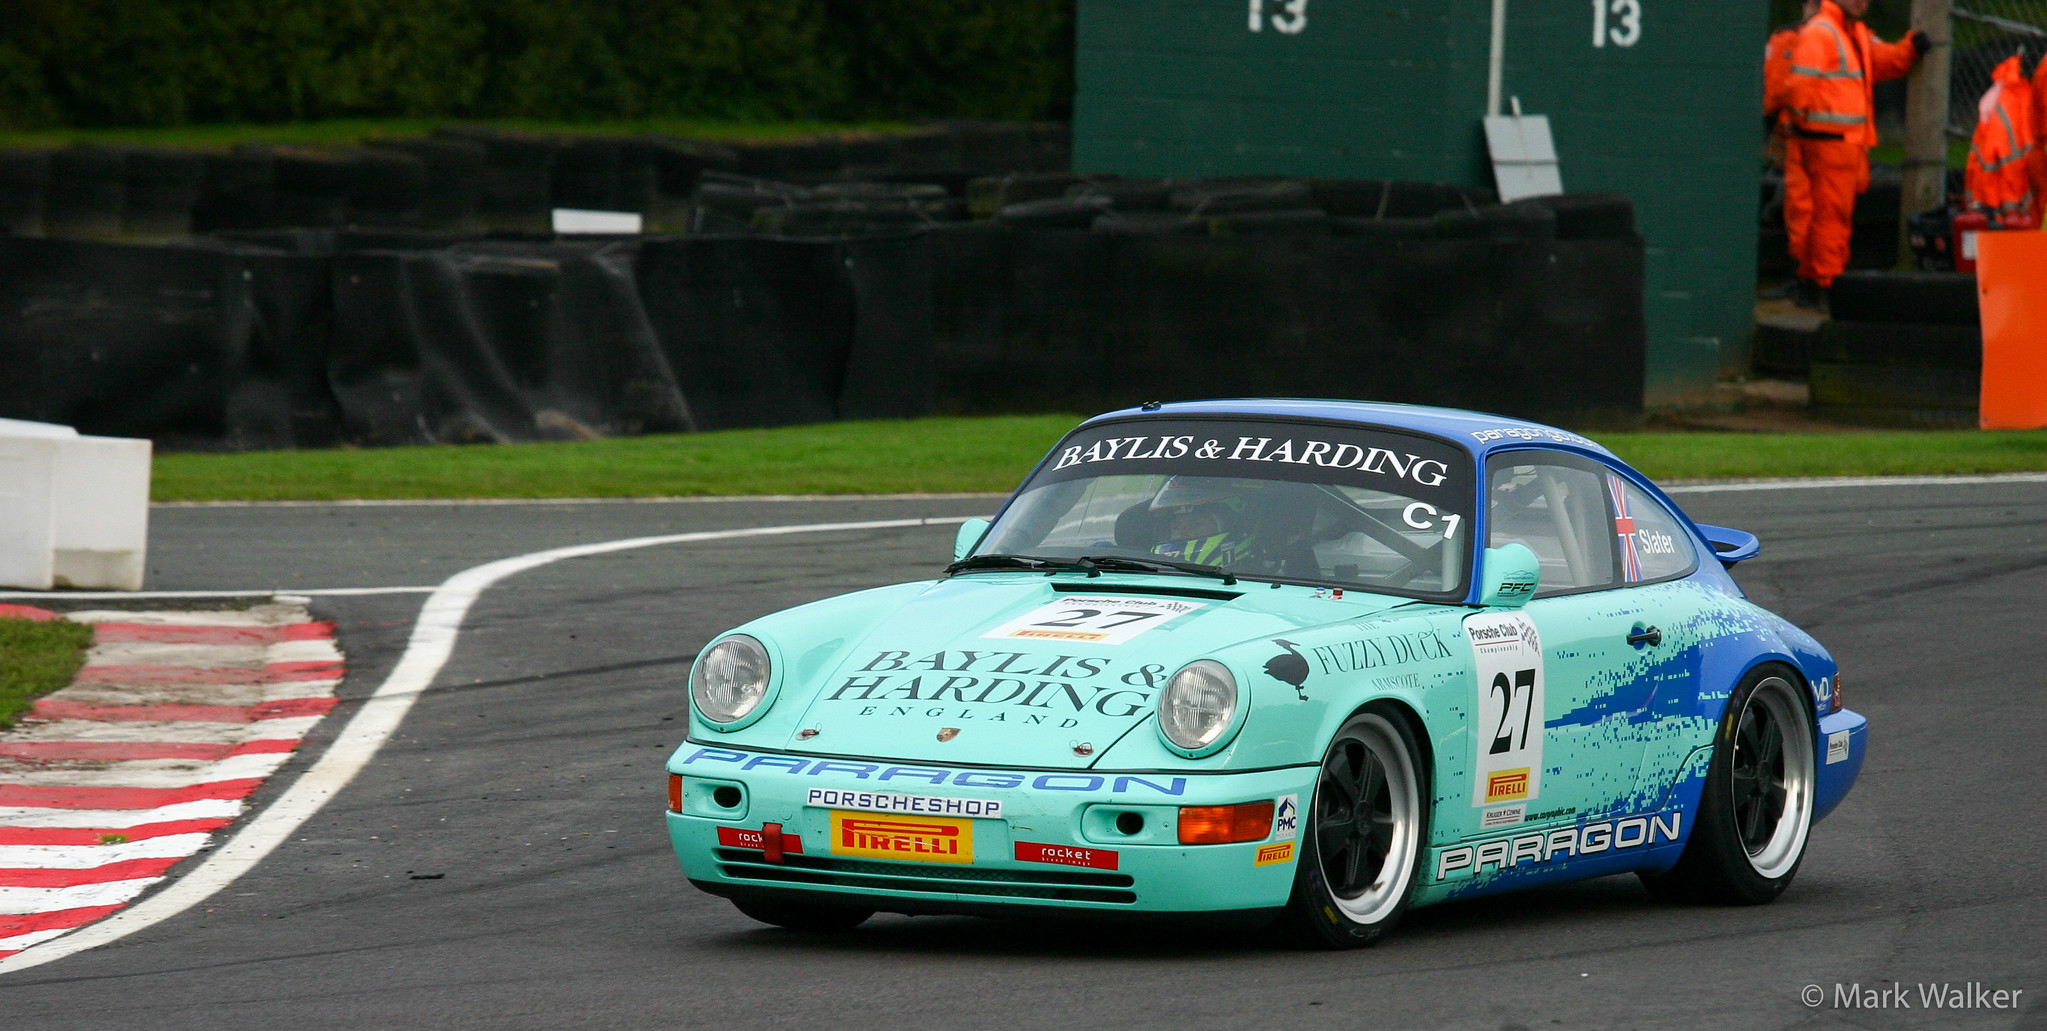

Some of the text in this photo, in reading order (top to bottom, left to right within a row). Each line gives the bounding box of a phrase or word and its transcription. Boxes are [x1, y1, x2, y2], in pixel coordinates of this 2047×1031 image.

[1248, 0, 1306, 33] 13
[1593, 0, 1641, 47] 13
[1052, 435, 1448, 487] BAYLIS & HARDING
[1402, 502, 1462, 540] C1
[1639, 529, 1675, 554] Slater
[1499, 583, 1535, 592] PFC
[1029, 609, 1164, 629] 27
[1468, 622, 1518, 641] Porsche Club
[1016, 630, 1102, 640] PIRELLI
[1312, 628, 1453, 676] FUZZY DUCK
[855, 650, 1168, 689] BAYLIS &
[1371, 673, 1421, 692] ARMSCOTE
[824, 675, 1150, 718] HARDING
[859, 705, 1079, 728] ENGLAND
[1489, 668, 1536, 755] 27
[683, 748, 1188, 796] PARAGON
[1488, 773, 1527, 797] PIRELLI
[808, 789, 1001, 816] PORSCHESHOP
[842, 817, 960, 855] PIRELLI
[1277, 816, 1297, 832] PMC
[739, 832, 763, 843] rock
[1436, 811, 1682, 881] PARAGON
[1041, 848, 1091, 860] rocket
[1258, 844, 1291, 862] PIRELLI
